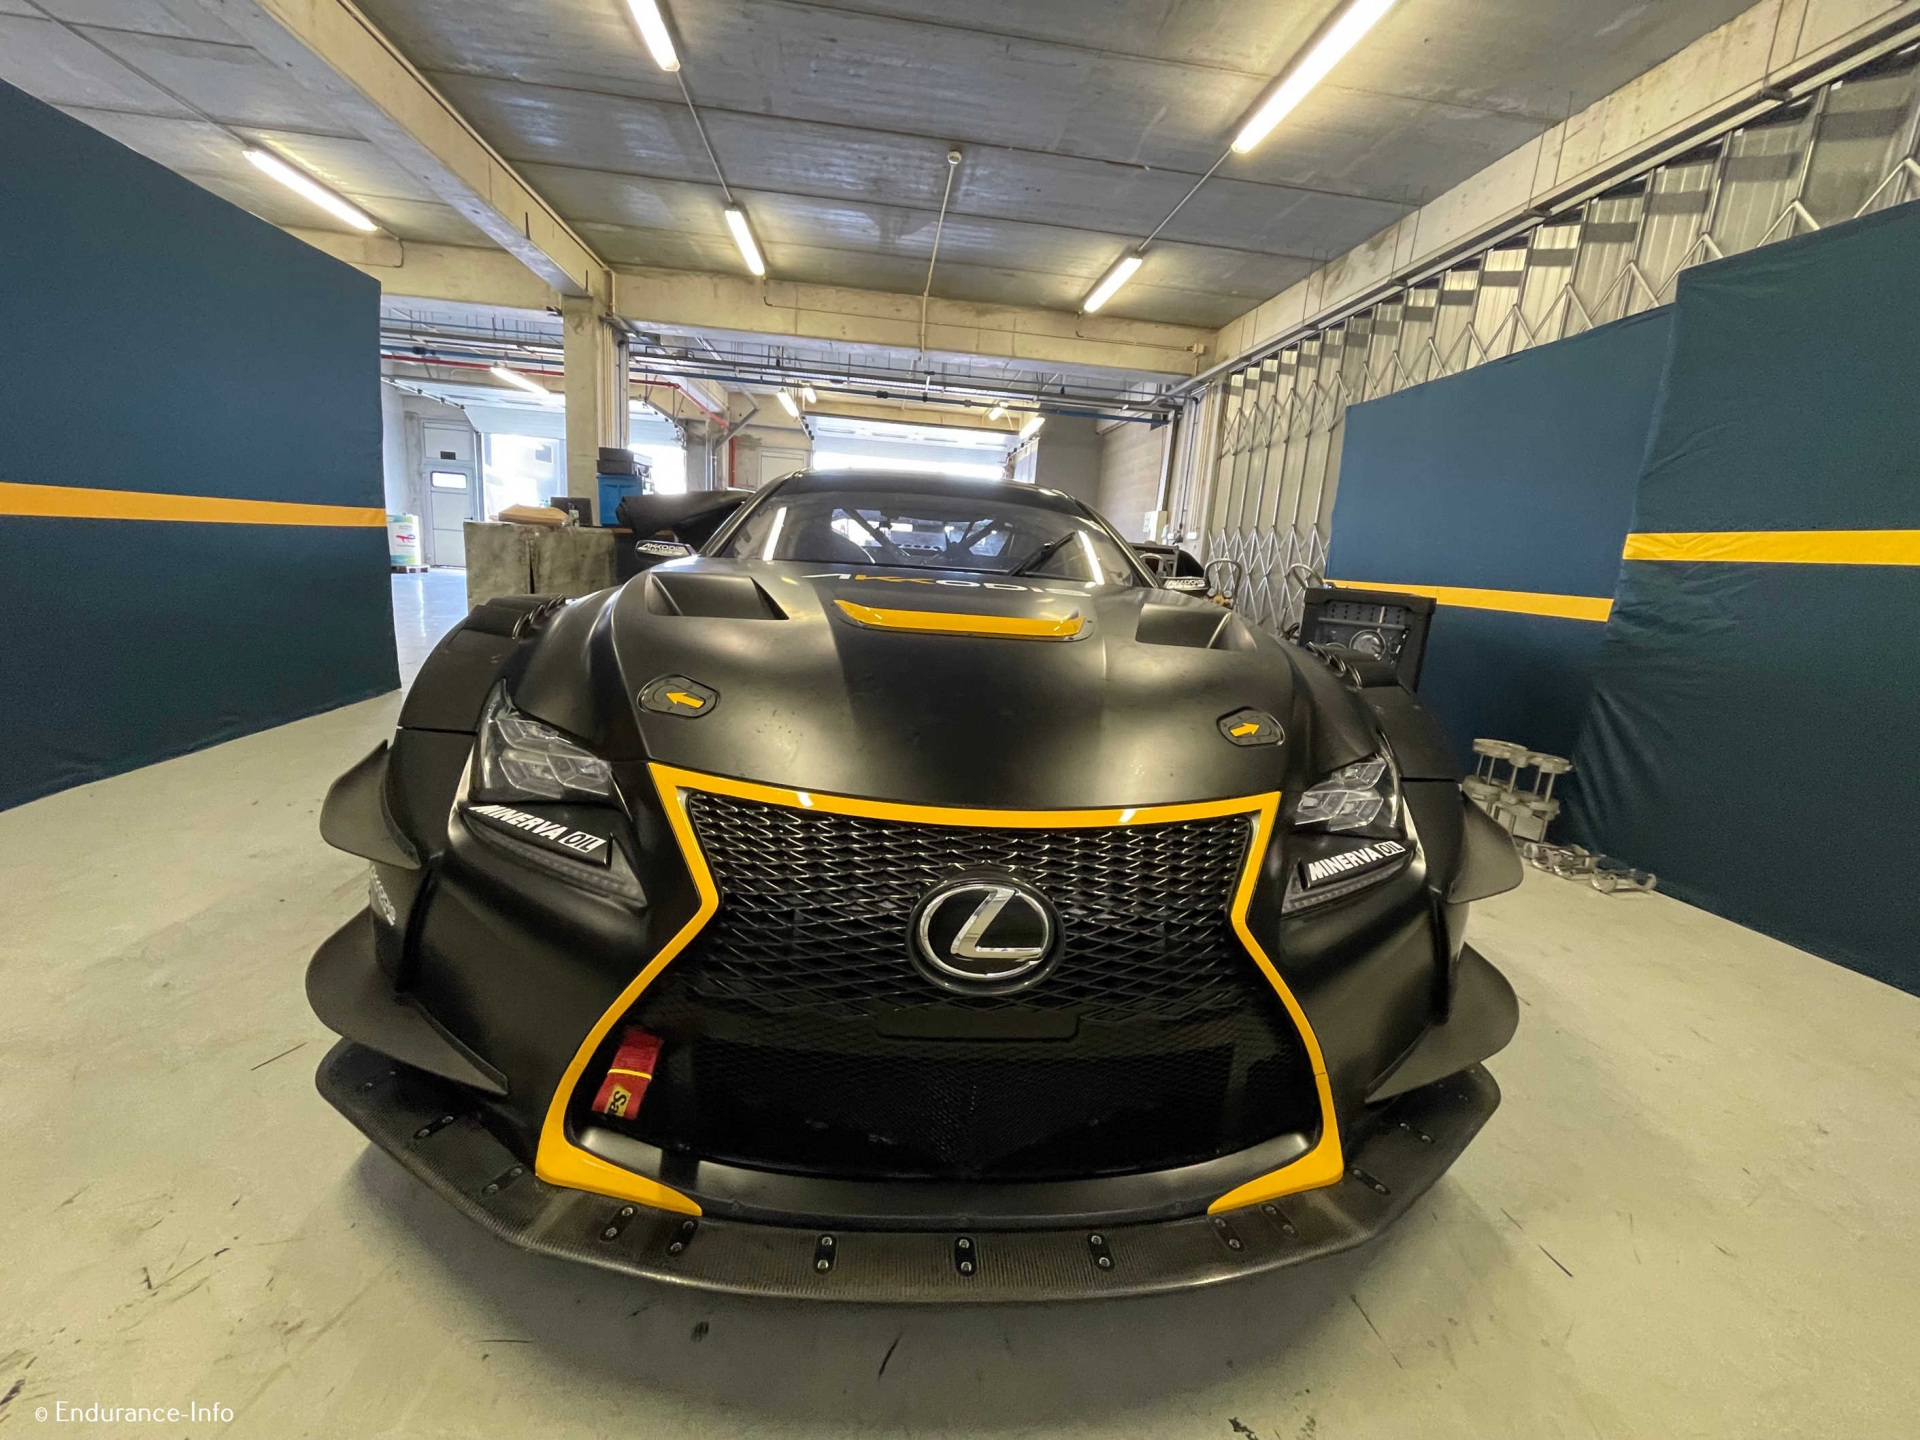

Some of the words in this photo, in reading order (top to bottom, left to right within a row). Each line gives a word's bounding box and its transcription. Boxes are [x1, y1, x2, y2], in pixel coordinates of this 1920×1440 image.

[801, 573, 1091, 597] AKKODIS
[468, 805, 568, 840] MINERVA
[562, 831, 602, 852] OIL
[1308, 847, 1383, 881] MINERVA
[1377, 841, 1405, 856] OIL
